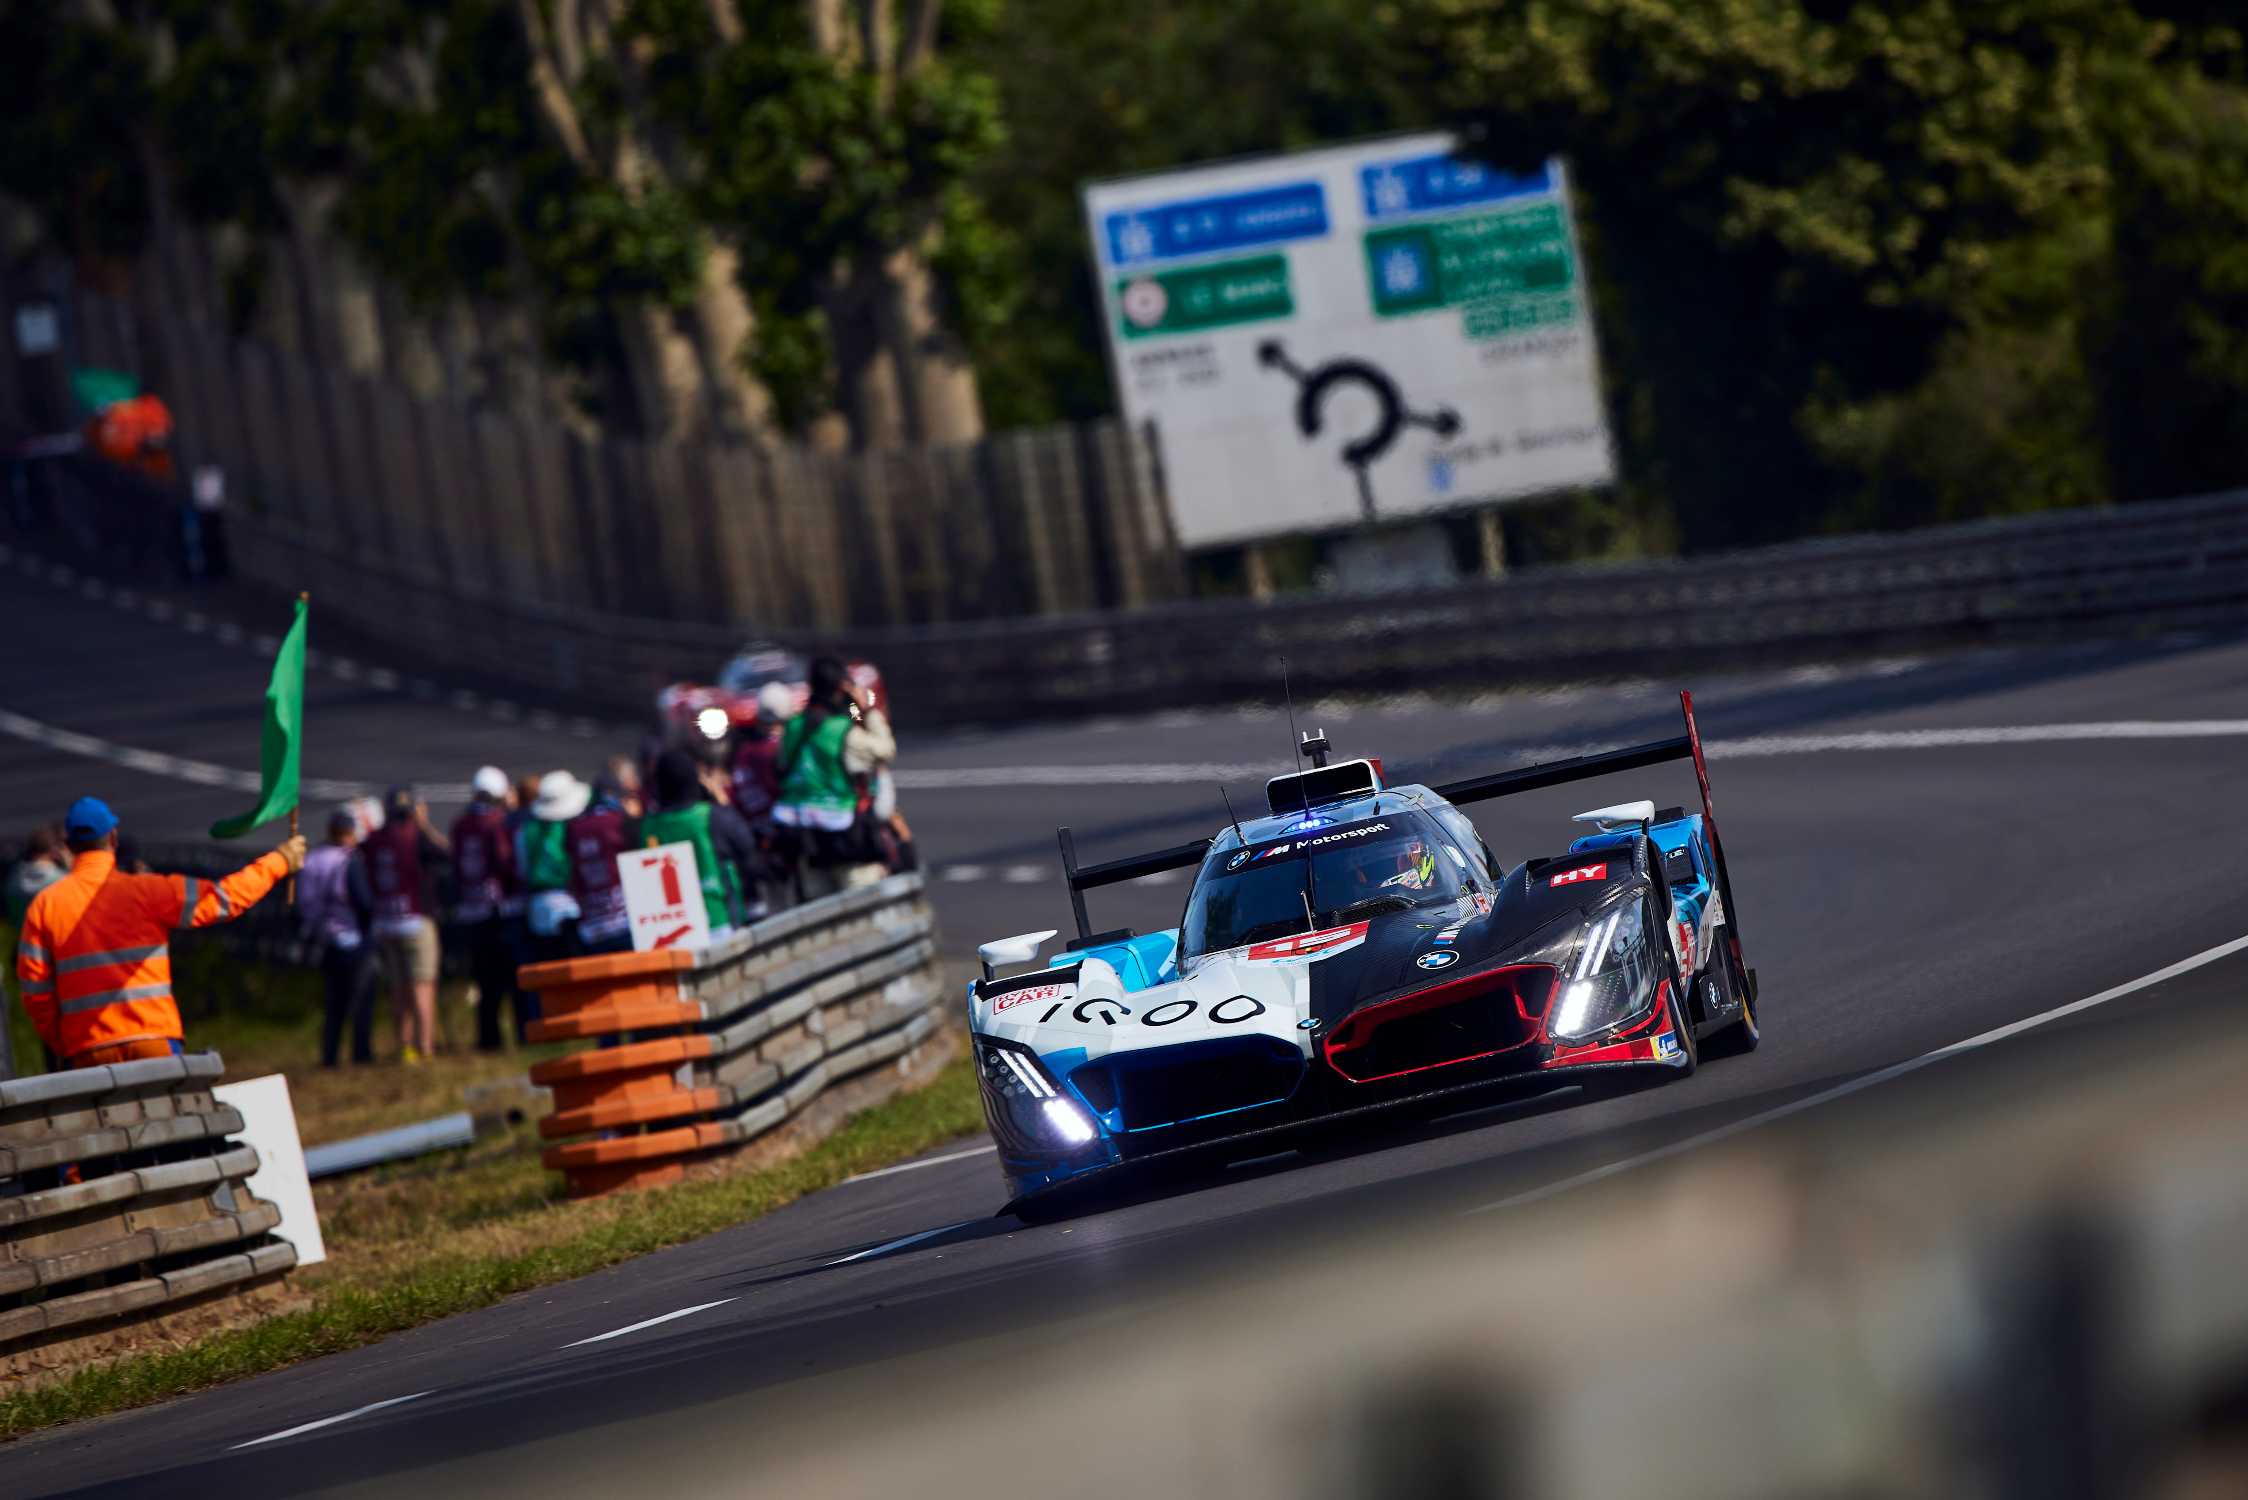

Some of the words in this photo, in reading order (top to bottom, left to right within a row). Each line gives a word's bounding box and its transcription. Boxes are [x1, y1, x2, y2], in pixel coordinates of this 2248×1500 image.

[1296, 823, 1391, 850] Motorsport
[1553, 865, 1603, 885] HY
[998, 991, 1055, 1010] CAR
